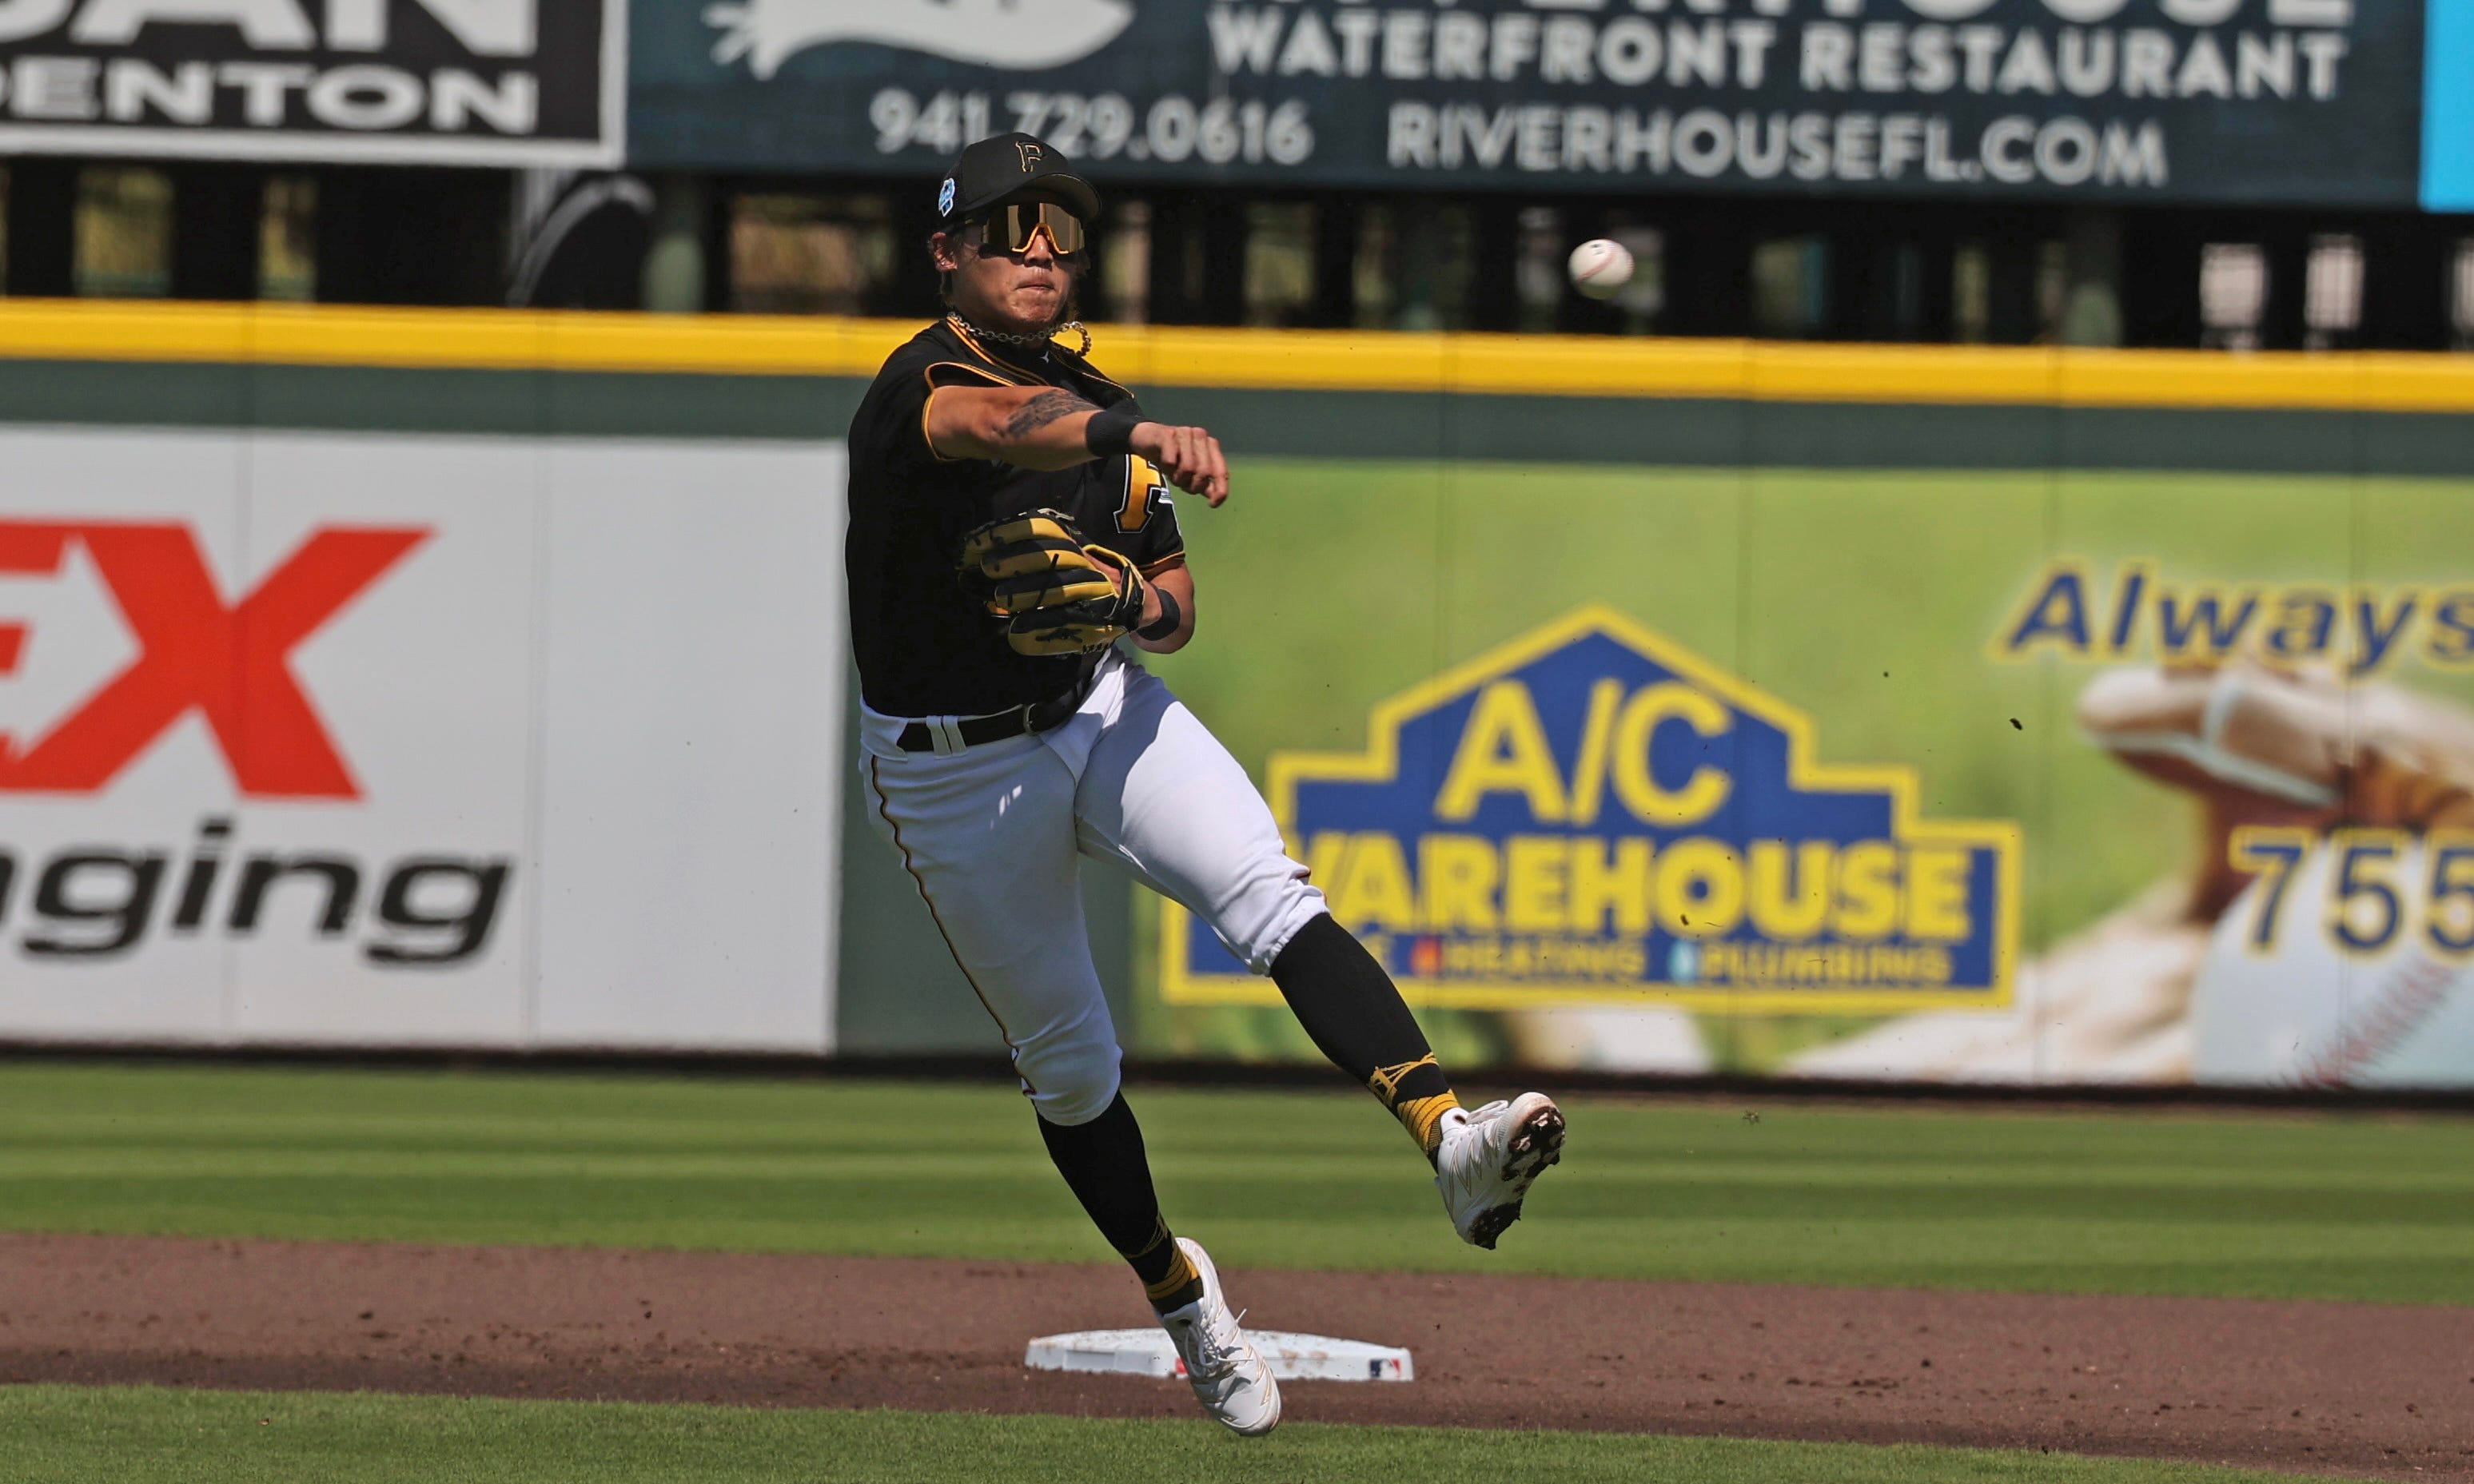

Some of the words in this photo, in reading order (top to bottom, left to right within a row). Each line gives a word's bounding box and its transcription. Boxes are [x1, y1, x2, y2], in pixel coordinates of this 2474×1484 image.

[0, 55, 539, 134] ENTON
[1206, 10, 1776, 87] WATERFRONT
[1800, 24, 2347, 100] RESTAURANT
[1387, 101, 2169, 185] RIVERHOUSEFL.COM
[1998, 564, 2474, 679] Always
[1436, 678, 1733, 826] A/C
[0, 817, 513, 967] ging
